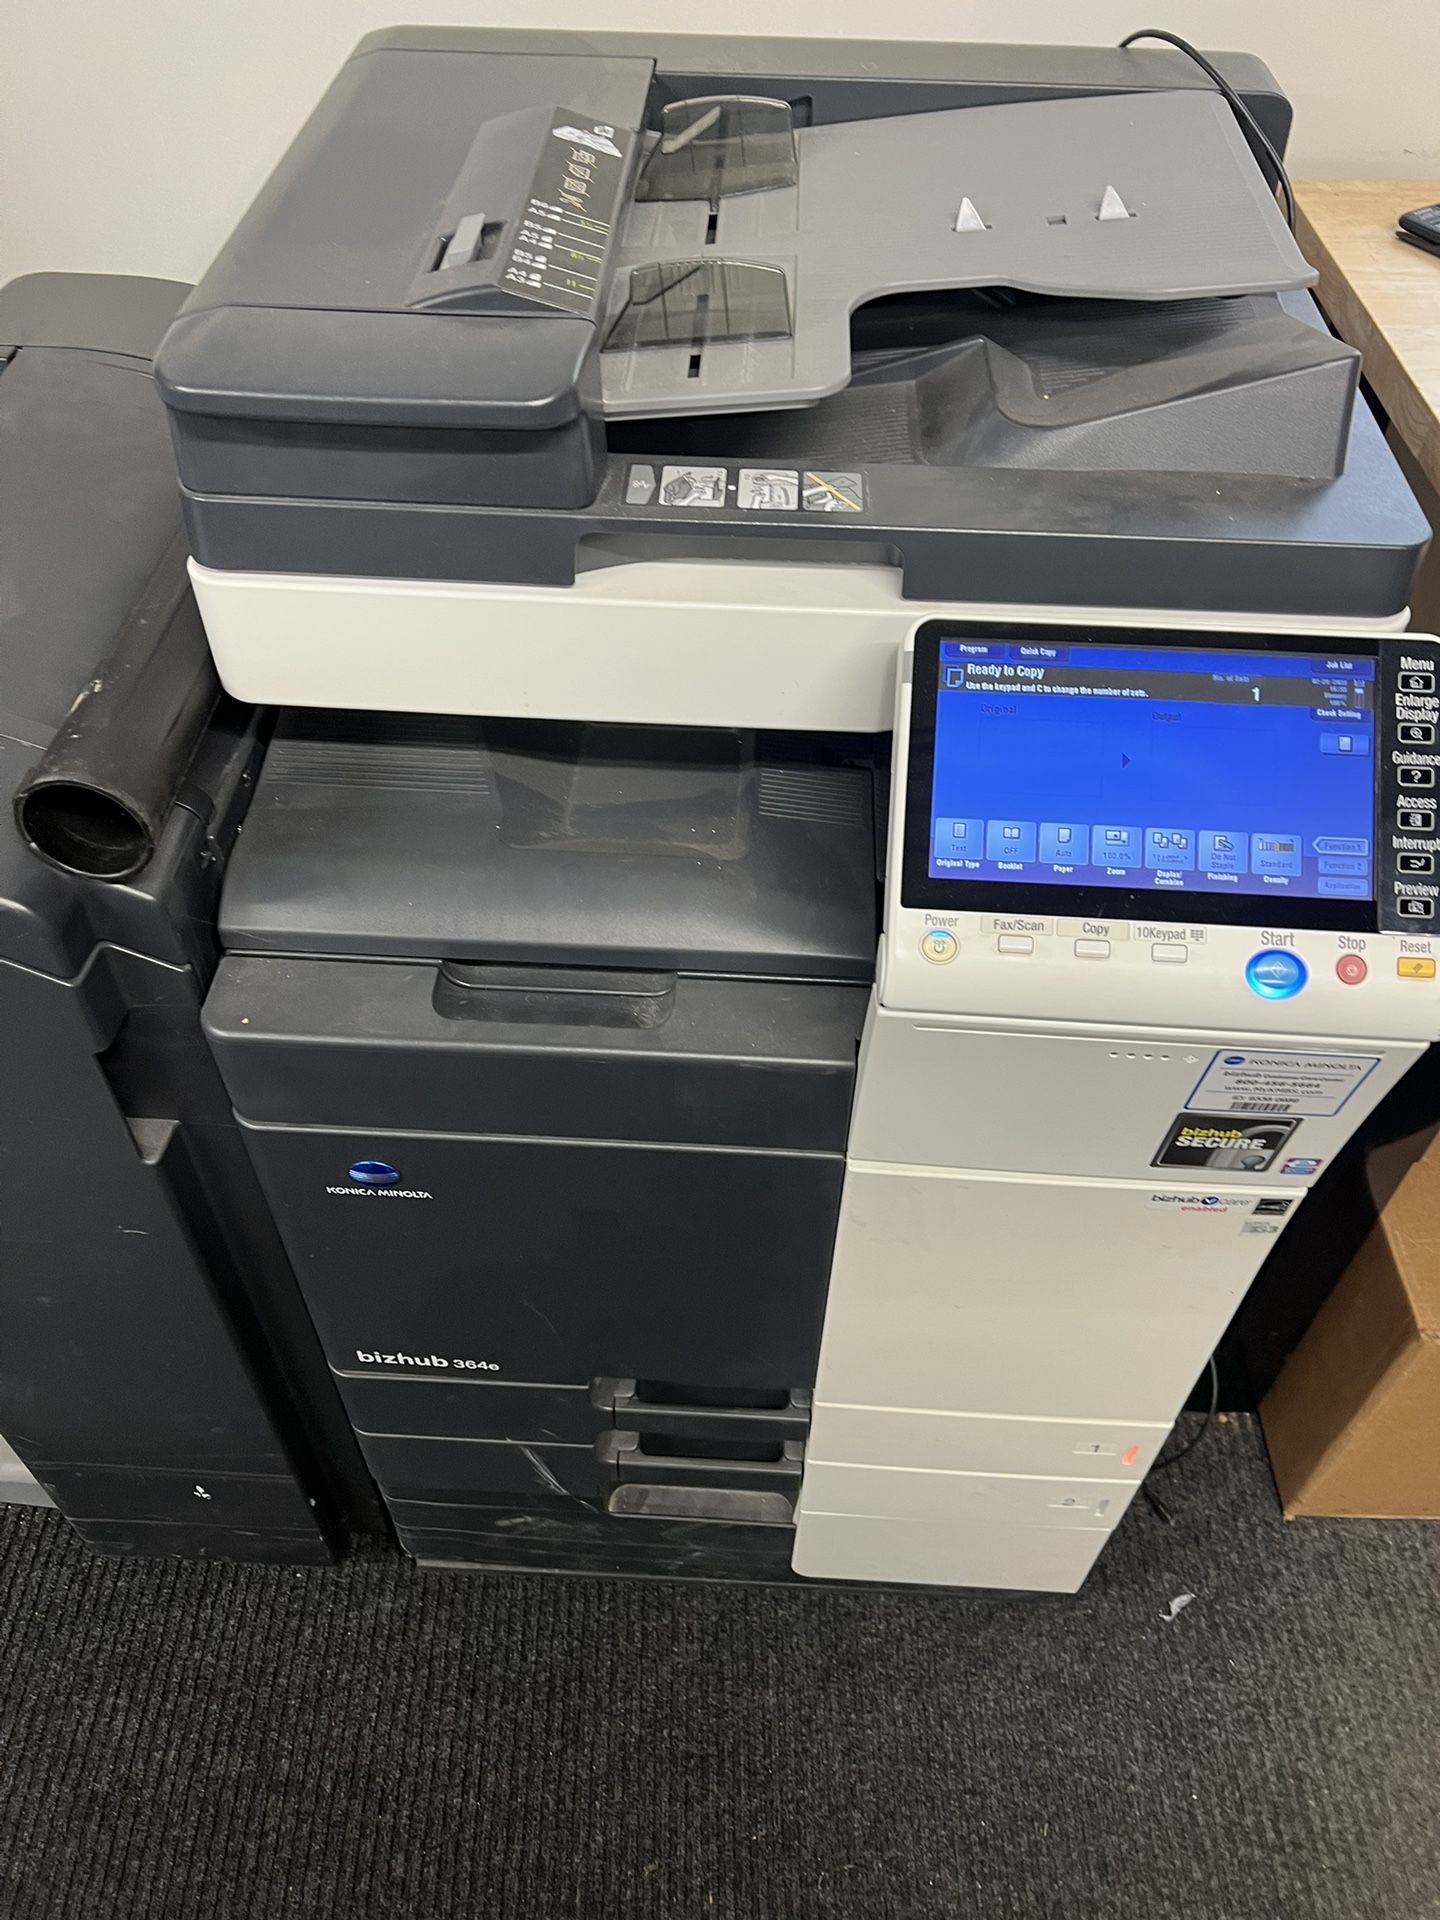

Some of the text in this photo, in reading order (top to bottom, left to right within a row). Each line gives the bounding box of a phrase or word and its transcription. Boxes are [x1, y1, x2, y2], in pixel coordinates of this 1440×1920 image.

[959, 644, 988, 654] Program
[1020, 646, 1057, 658] Quick Copy
[1400, 656, 1435, 671] Menu
[967, 664, 1045, 680] Ready to Copy
[966, 681, 980, 690] Use
[981, 681, 993, 690] the
[994, 682, 1021, 692] keypad
[1022, 683, 1036, 693] and
[1037, 684, 1043, 692] C
[1043, 685, 1052, 693] to
[1052, 685, 1079, 696] change
[1080, 686, 1092, 695] the
[1093, 687, 1121, 696] number
[1122, 688, 1130, 697] of
[1251, 687, 1260, 702] 1
[1394, 692, 1440, 710] Enlarge
[980, 703, 1017, 714] Original
[1395, 706, 1440, 724] Display
[1392, 750, 1440, 766] Guidance
[1396, 794, 1438, 810] Access
[1004, 846, 1019, 854] OFF
[1324, 842, 1355, 852] Function
[1392, 835, 1440, 854] Interrupt
[936, 858, 981, 870] Original Type
[1211, 853, 1237, 862] Do Not
[998, 862, 1024, 871] Booklet
[1053, 864, 1074, 874] Paper
[1106, 867, 1126, 876] Zoom
[1211, 861, 1235, 871] Staple
[1260, 860, 1293, 870] Standard
[1324, 860, 1355, 870] Function
[1394, 881, 1440, 896] Preview
[924, 914, 960, 928] Power
[993, 918, 1045, 932] Fax/Scan
[1082, 922, 1110, 936] Copy
[1136, 925, 1187, 942] 10Keypad
[1260, 930, 1295, 947] Start
[1338, 935, 1367, 952] Stop
[1400, 939, 1432, 954] Reset
[1180, 1126, 1244, 1139] bizhub
[1174, 1136, 1267, 1150] SECURE
[326, 1186, 434, 1200] KONICA MINOLTA
[1152, 1194, 1201, 1205] bizhub
[1180, 1206, 1228, 1214] enabled
[356, 1350, 501, 1372] bizhub 364e
